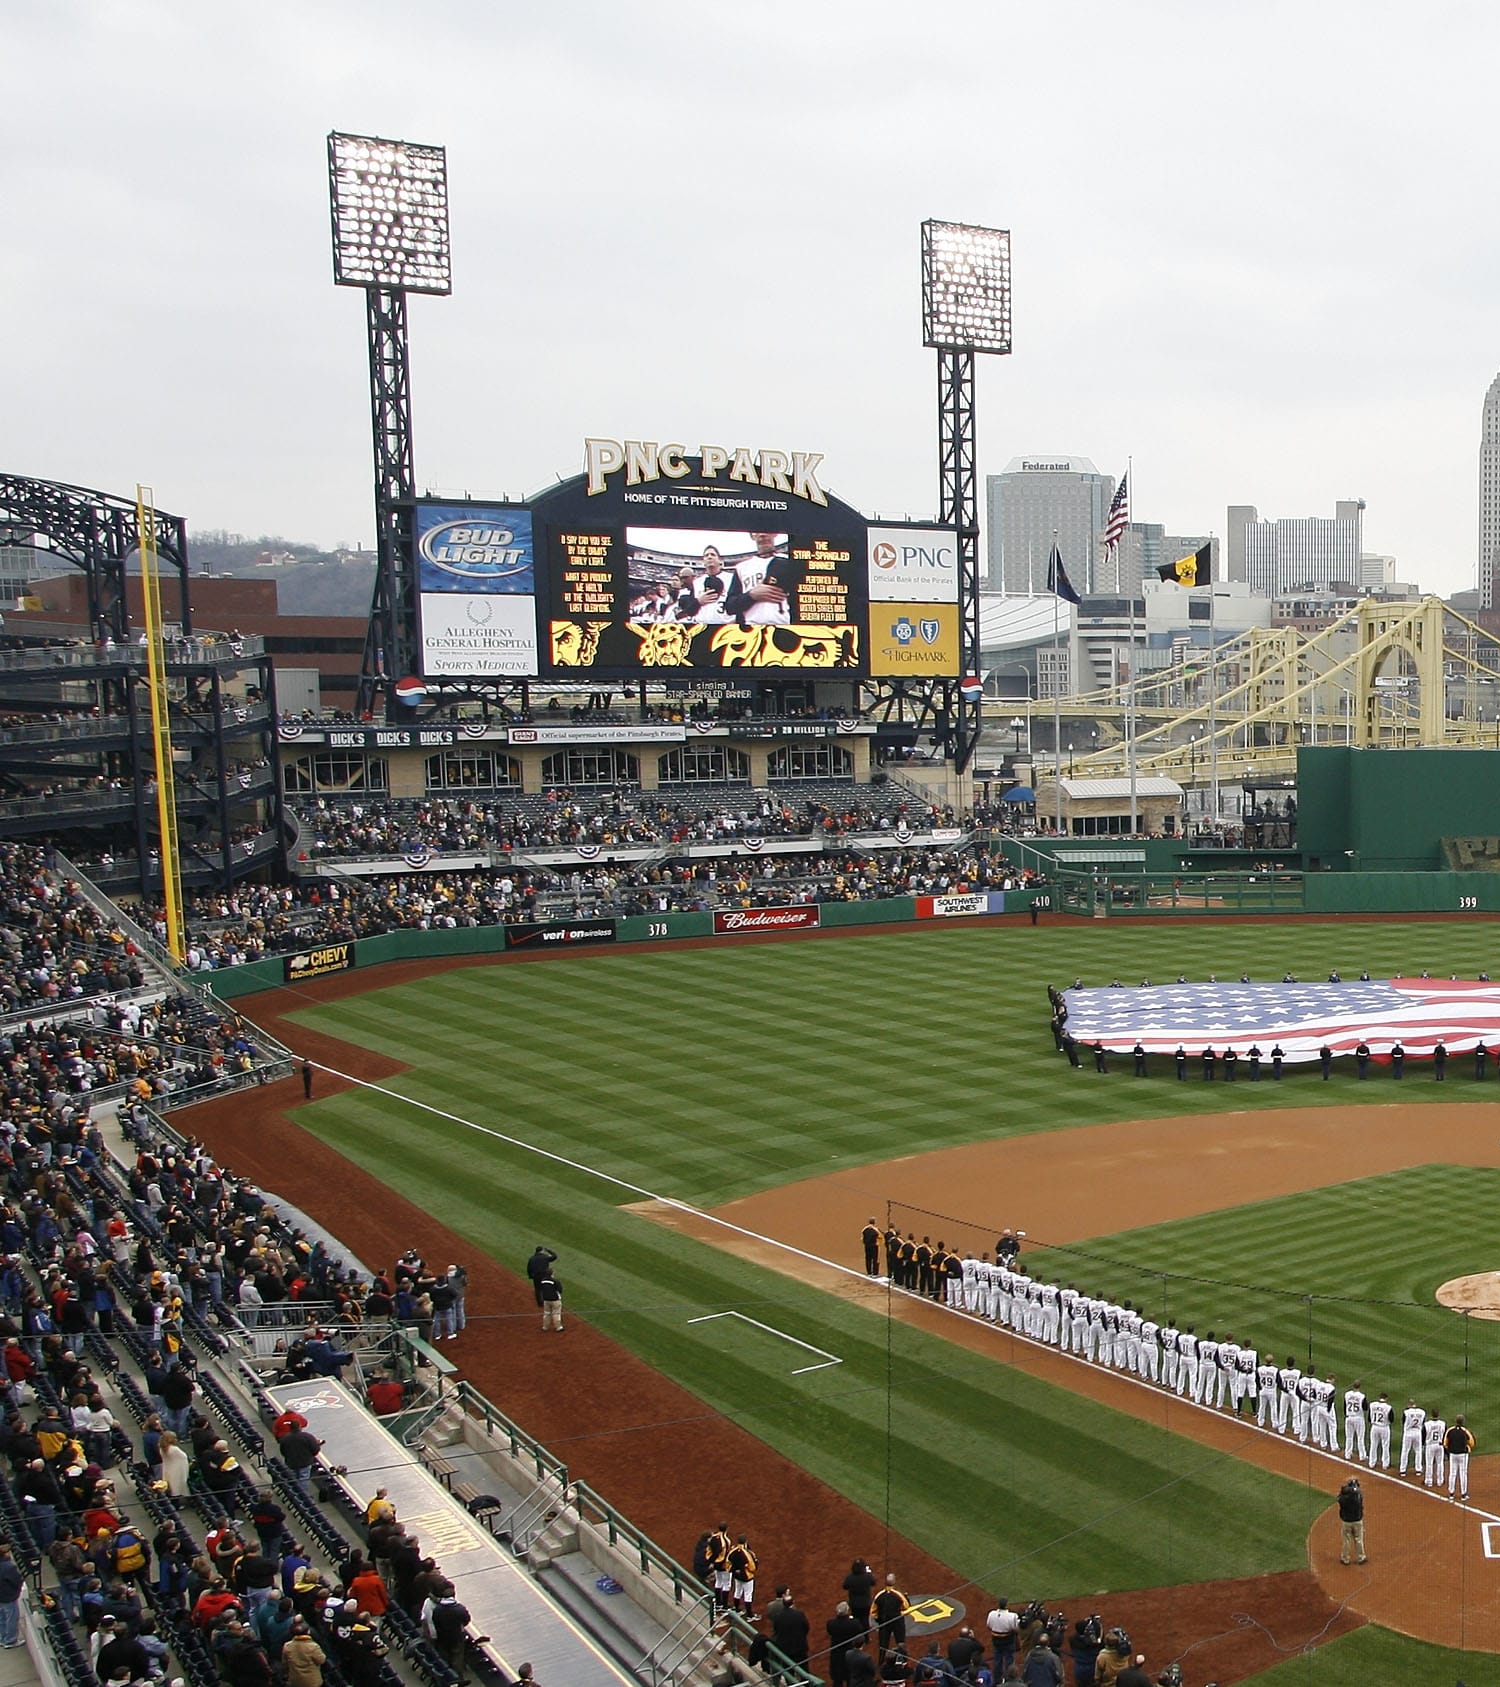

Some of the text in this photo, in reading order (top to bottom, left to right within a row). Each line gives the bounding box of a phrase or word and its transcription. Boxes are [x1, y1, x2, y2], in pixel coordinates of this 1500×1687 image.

[1022, 461, 1070, 471] Federated
[585, 438, 828, 507] PNC PARK
[624, 493, 787, 511] HOME OF THE PITTSBURGH PIRATES
[448, 528, 514, 546] BUD
[814, 541, 828, 550] THE
[436, 546, 525, 565] LIGHT
[793, 550, 850, 561] STAR-SPANGLED
[901, 546, 953, 569] PNC
[873, 575, 895, 583] Official
[931, 577, 953, 585] Pirates
[445, 627, 515, 637] ALLEGHENY
[426, 637, 535, 648] GENERAL HOSPITAL
[888, 649, 949, 662] HIGHMARK
[434, 660, 529, 670] SPORTS MEDICINE
[667, 690, 723, 699] STAR-SPANGLED
[937, 896, 984, 907] SOUTHWEST
[1459, 896, 1477, 908] 399
[944, 904, 977, 913] AIRLINES
[723, 911, 807, 928] Budweiser
[649, 923, 668, 936] 378
[543, 929, 584, 943] verizon
[311, 945, 348, 966] CHEVY
[1223, 1354, 1235, 1364] 35
[1241, 1360, 1253, 1370] 29
[1261, 1377, 1273, 1387] 49
[1285, 1380, 1295, 1390] 19
[1373, 1413, 1384, 1423] 12
[1412, 1419, 1419, 1428] 2
[1432, 1431, 1439, 1441] 6
